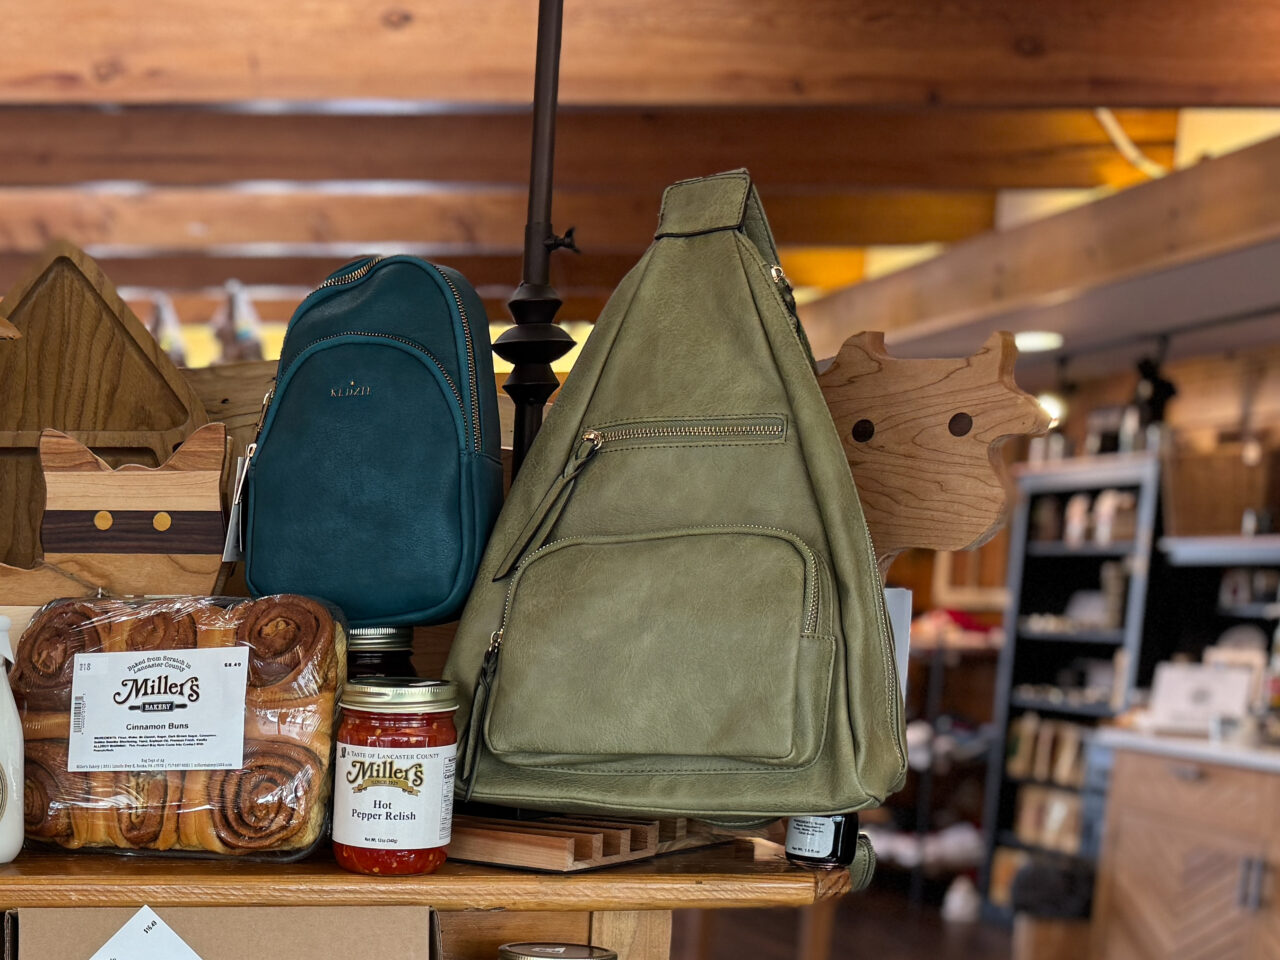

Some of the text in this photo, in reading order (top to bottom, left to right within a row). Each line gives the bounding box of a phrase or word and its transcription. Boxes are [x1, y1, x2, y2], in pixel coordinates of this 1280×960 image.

[127, 658, 146, 672] Baked
[162, 655, 185, 666] Scratch
[133, 662, 186, 674] Lancaster County
[113, 675, 200, 705] Miller's
[346, 760, 424, 786] Miller's
[373, 800, 392, 810] Hot
[351, 808, 416, 821] Pepper Relish
